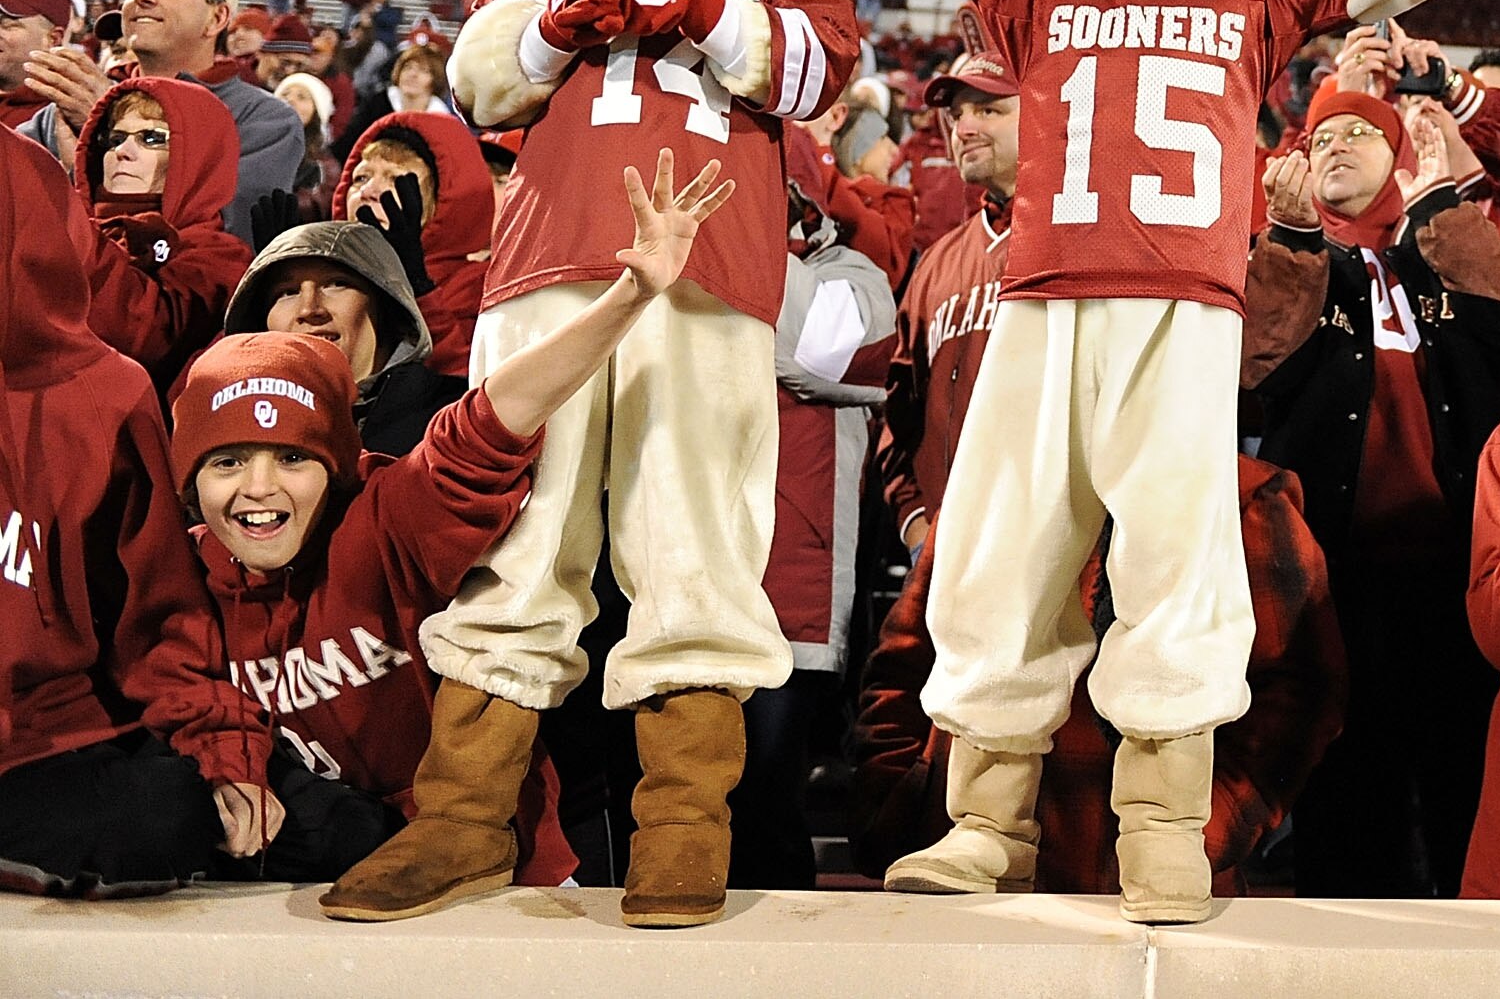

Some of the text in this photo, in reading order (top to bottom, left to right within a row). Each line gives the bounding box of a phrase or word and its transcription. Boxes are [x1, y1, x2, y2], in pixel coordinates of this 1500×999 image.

[1047, 4, 1246, 61] SOONERS
[1052, 55, 1226, 229] 15
[211, 377, 316, 412] OKLAHOMA
[254, 400, 278, 429] OU
